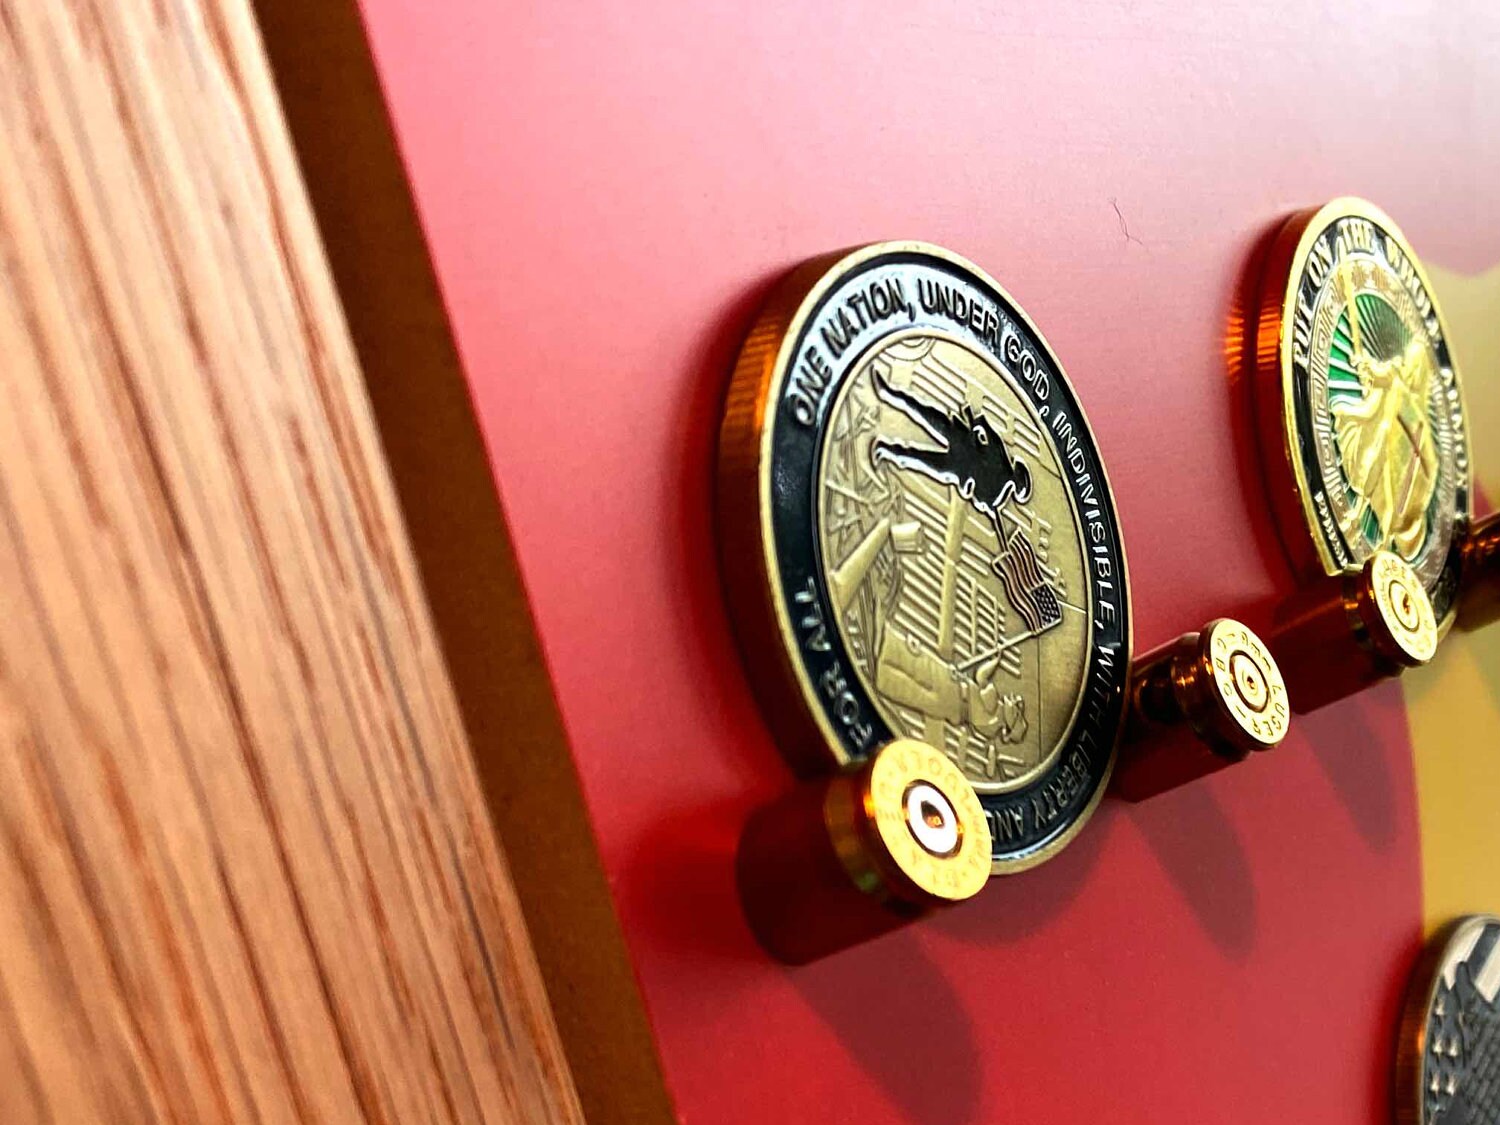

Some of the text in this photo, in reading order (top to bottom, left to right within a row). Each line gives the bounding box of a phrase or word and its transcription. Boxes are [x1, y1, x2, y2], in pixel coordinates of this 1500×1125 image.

[820, 277, 916, 359] NATION,
[917, 277, 1000, 345] UNDER
[1293, 288, 1314, 370] PUT
[1309, 234, 1334, 288] ON
[1337, 217, 1375, 254] THE
[790, 345, 833, 426] ONE
[1003, 333, 1050, 419] GOD,
[1052, 411, 1116, 631] INDIVISIBLE,
[795, 576, 873, 748] FOR ALL
[1088, 643, 1117, 723] WITH
[1032, 729, 1100, 830] LIBERTY
